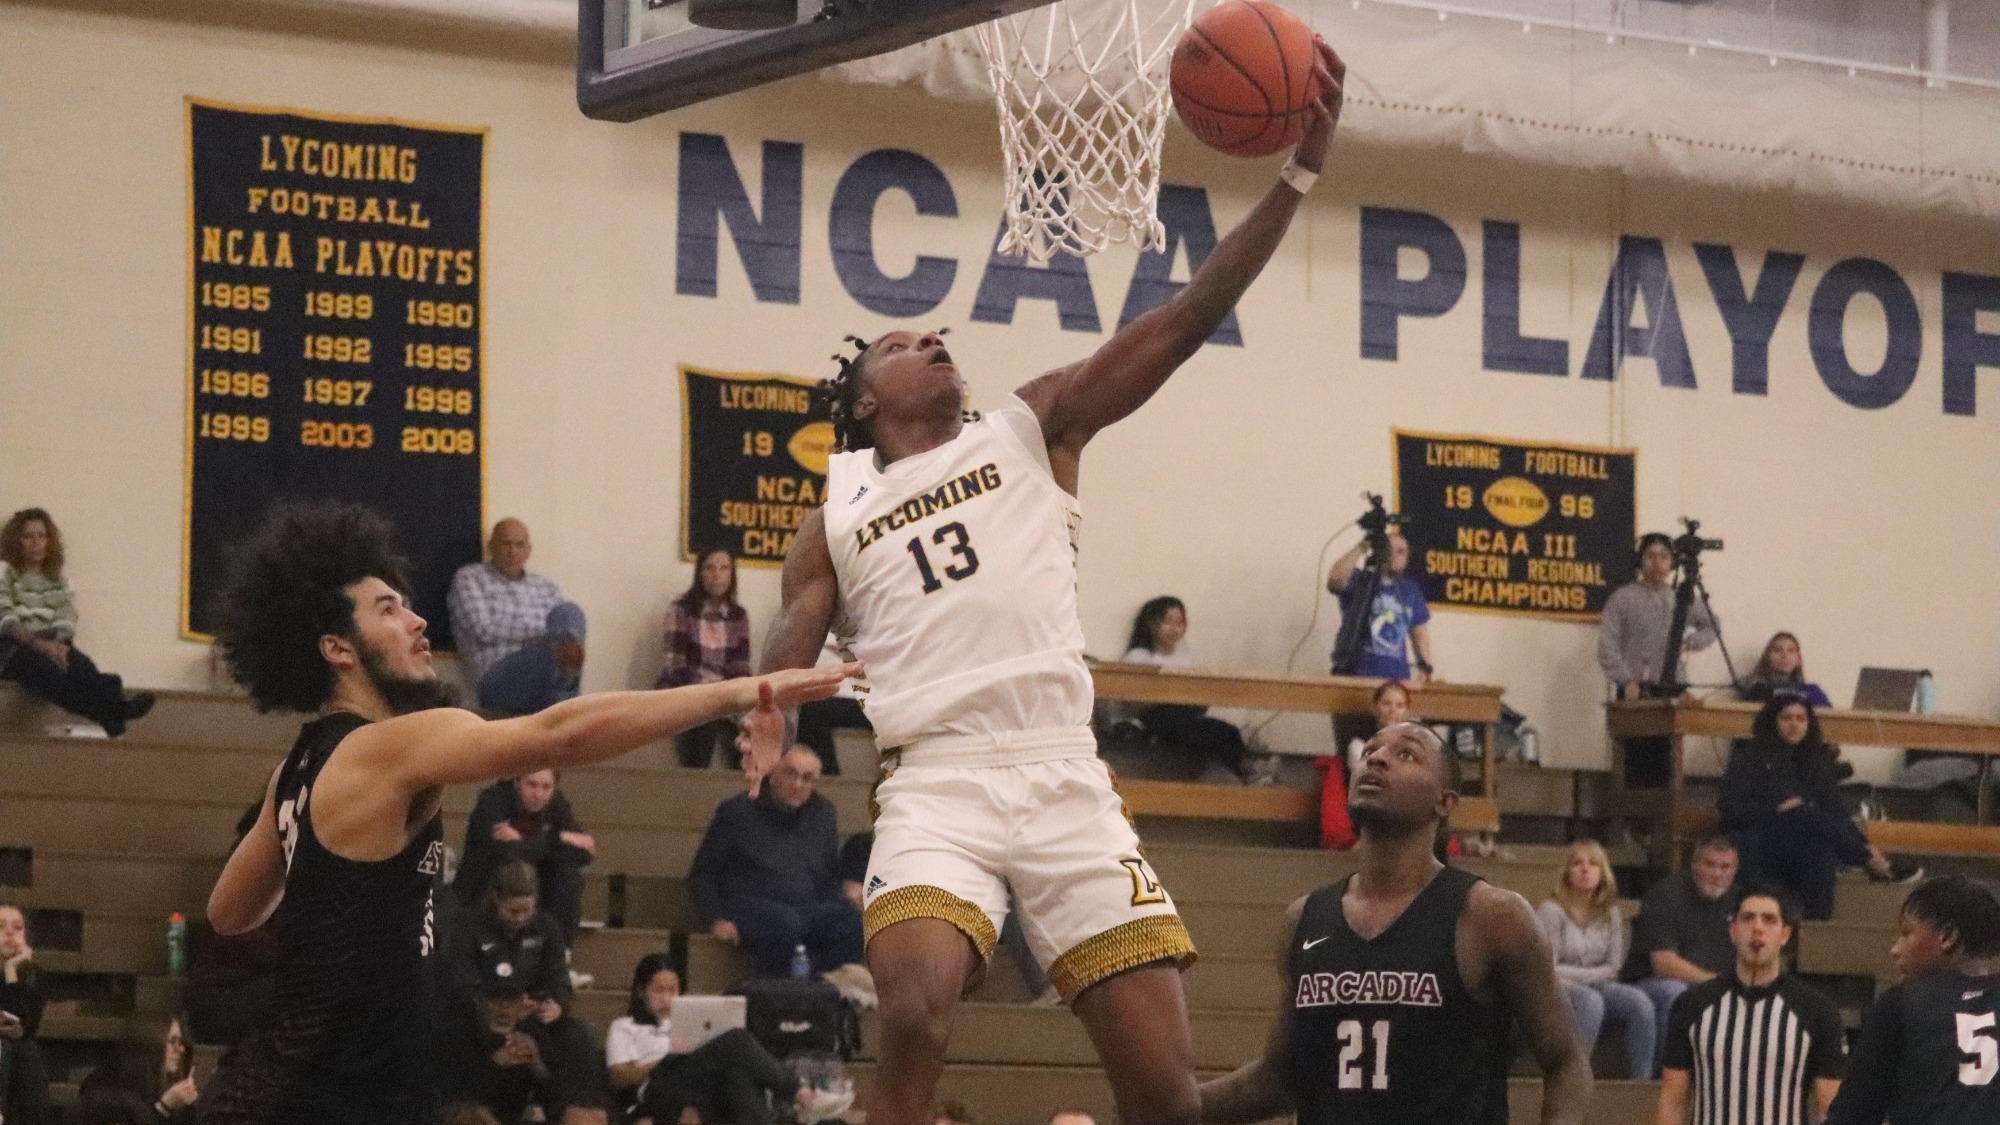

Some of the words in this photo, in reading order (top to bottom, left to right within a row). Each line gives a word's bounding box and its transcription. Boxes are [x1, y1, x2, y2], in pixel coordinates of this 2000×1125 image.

[260, 134, 418, 184] LYCOMING
[247, 187, 431, 229] FOOTBALL
[202, 226, 294, 269] NCAA
[316, 237, 474, 286] PLAYOFFS
[675, 131, 1244, 348] NCAA
[201, 281, 272, 312] 1985
[304, 291, 374, 320] 1989
[406, 299, 474, 329] 1990
[201, 324, 262, 354] 1991
[303, 334, 372, 364] 1992
[404, 342, 473, 372] 1995
[200, 368, 271, 399] 1996
[303, 377, 374, 407] 1997
[404, 385, 473, 415] 1998
[719, 382, 811, 415] LYCOMING
[200, 412, 271, 443] 1999
[301, 420, 374, 450] 2003
[402, 427, 475, 455] 2008
[742, 430, 774, 457] 19
[1425, 441, 1501, 471] LYCOMING
[1525, 450, 1609, 480] FOOTBALL
[719, 501, 811, 529] SOUTHER
[854, 462, 1003, 556] LYCOMING
[1445, 485, 1473, 511] 19
[906, 520, 981, 595] 13
[1457, 526, 1530, 555] NCAA
[1544, 533, 1577, 559] III
[1425, 551, 1509, 579] SOUTHERN
[1527, 558, 1607, 587] REGIONAL
[1446, 578, 1588, 610] CHAMPIONS
[1119, 858, 1167, 907] L
[1295, 971, 1443, 1008] ARCADIA
[1336, 1019, 1390, 1090] 21
[1954, 1010, 1999, 1086] 5
